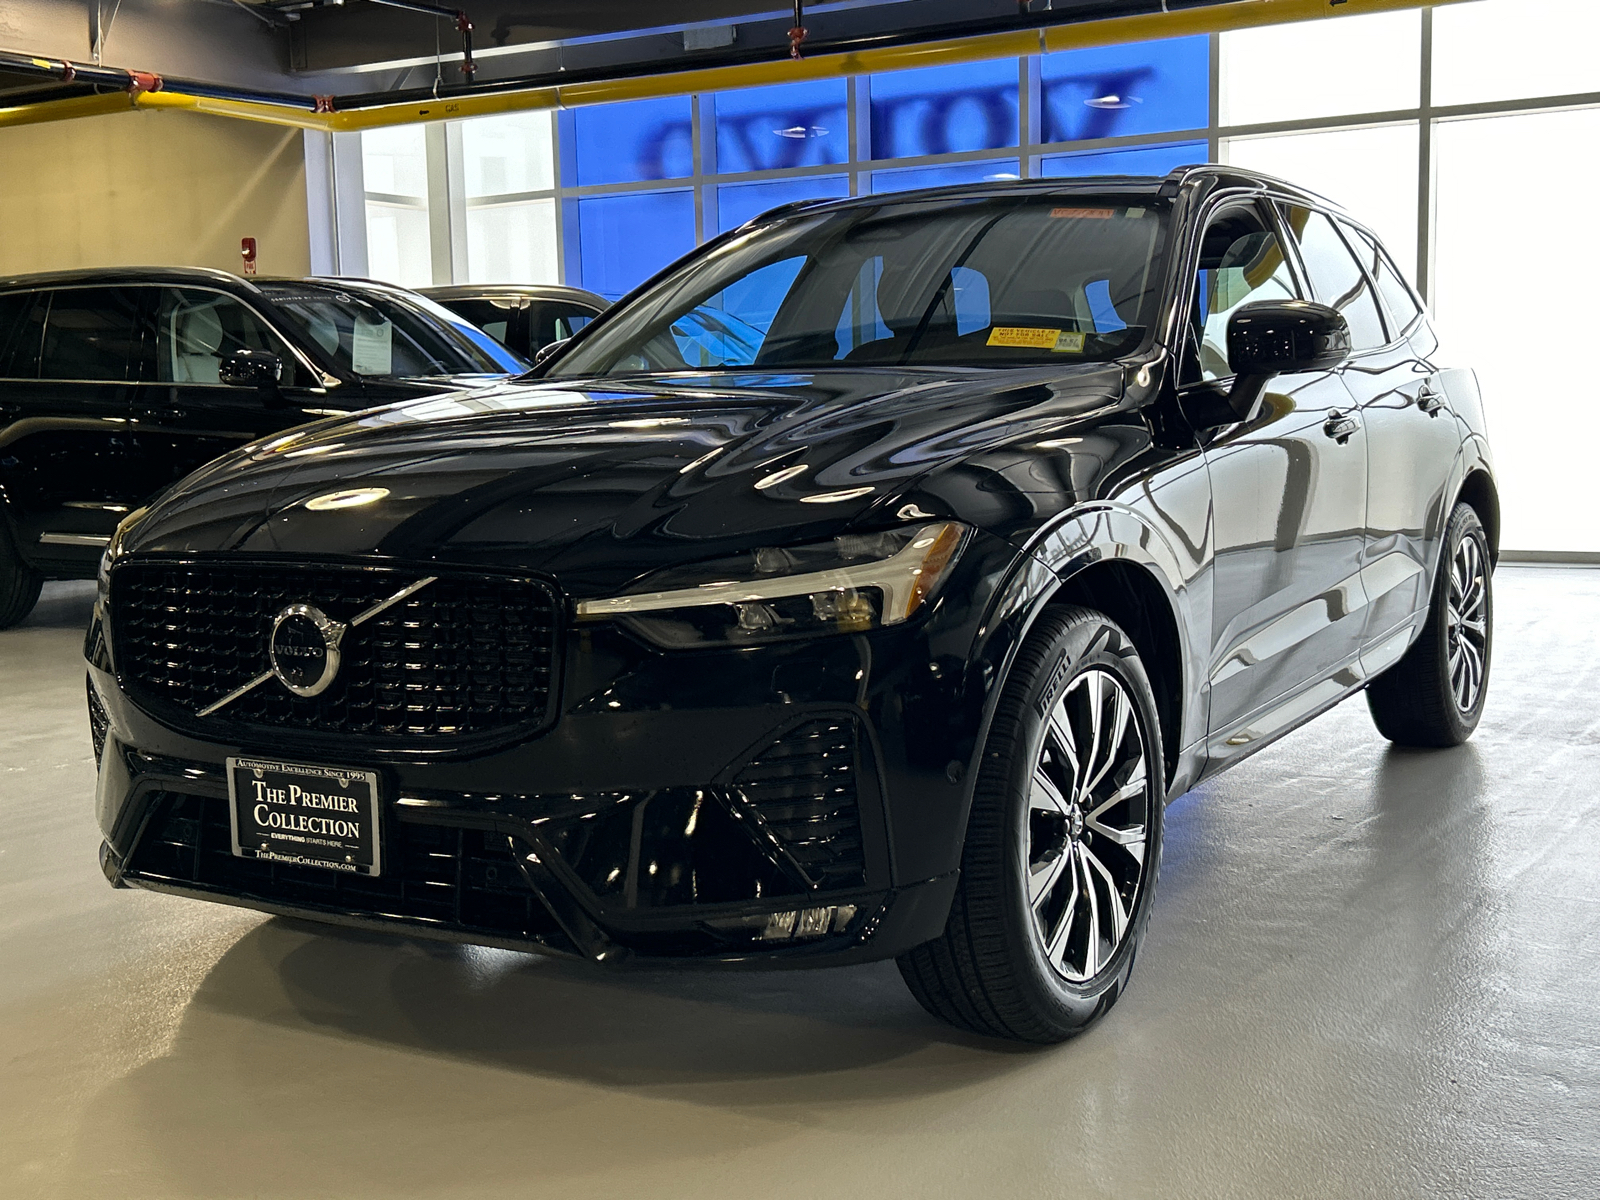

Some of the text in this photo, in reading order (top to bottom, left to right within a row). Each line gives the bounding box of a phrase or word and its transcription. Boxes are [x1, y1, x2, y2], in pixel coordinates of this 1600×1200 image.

[274, 644, 324, 658] VOLVO
[237, 759, 365, 781] AUTOMOTIVE EXCELLENCE SINCE 1995
[252, 780, 359, 813] THE PREMIER
[253, 803, 360, 839] COLLECTION
[270, 832, 306, 843] EVERYTHING
[306, 837, 327, 846] STARTS
